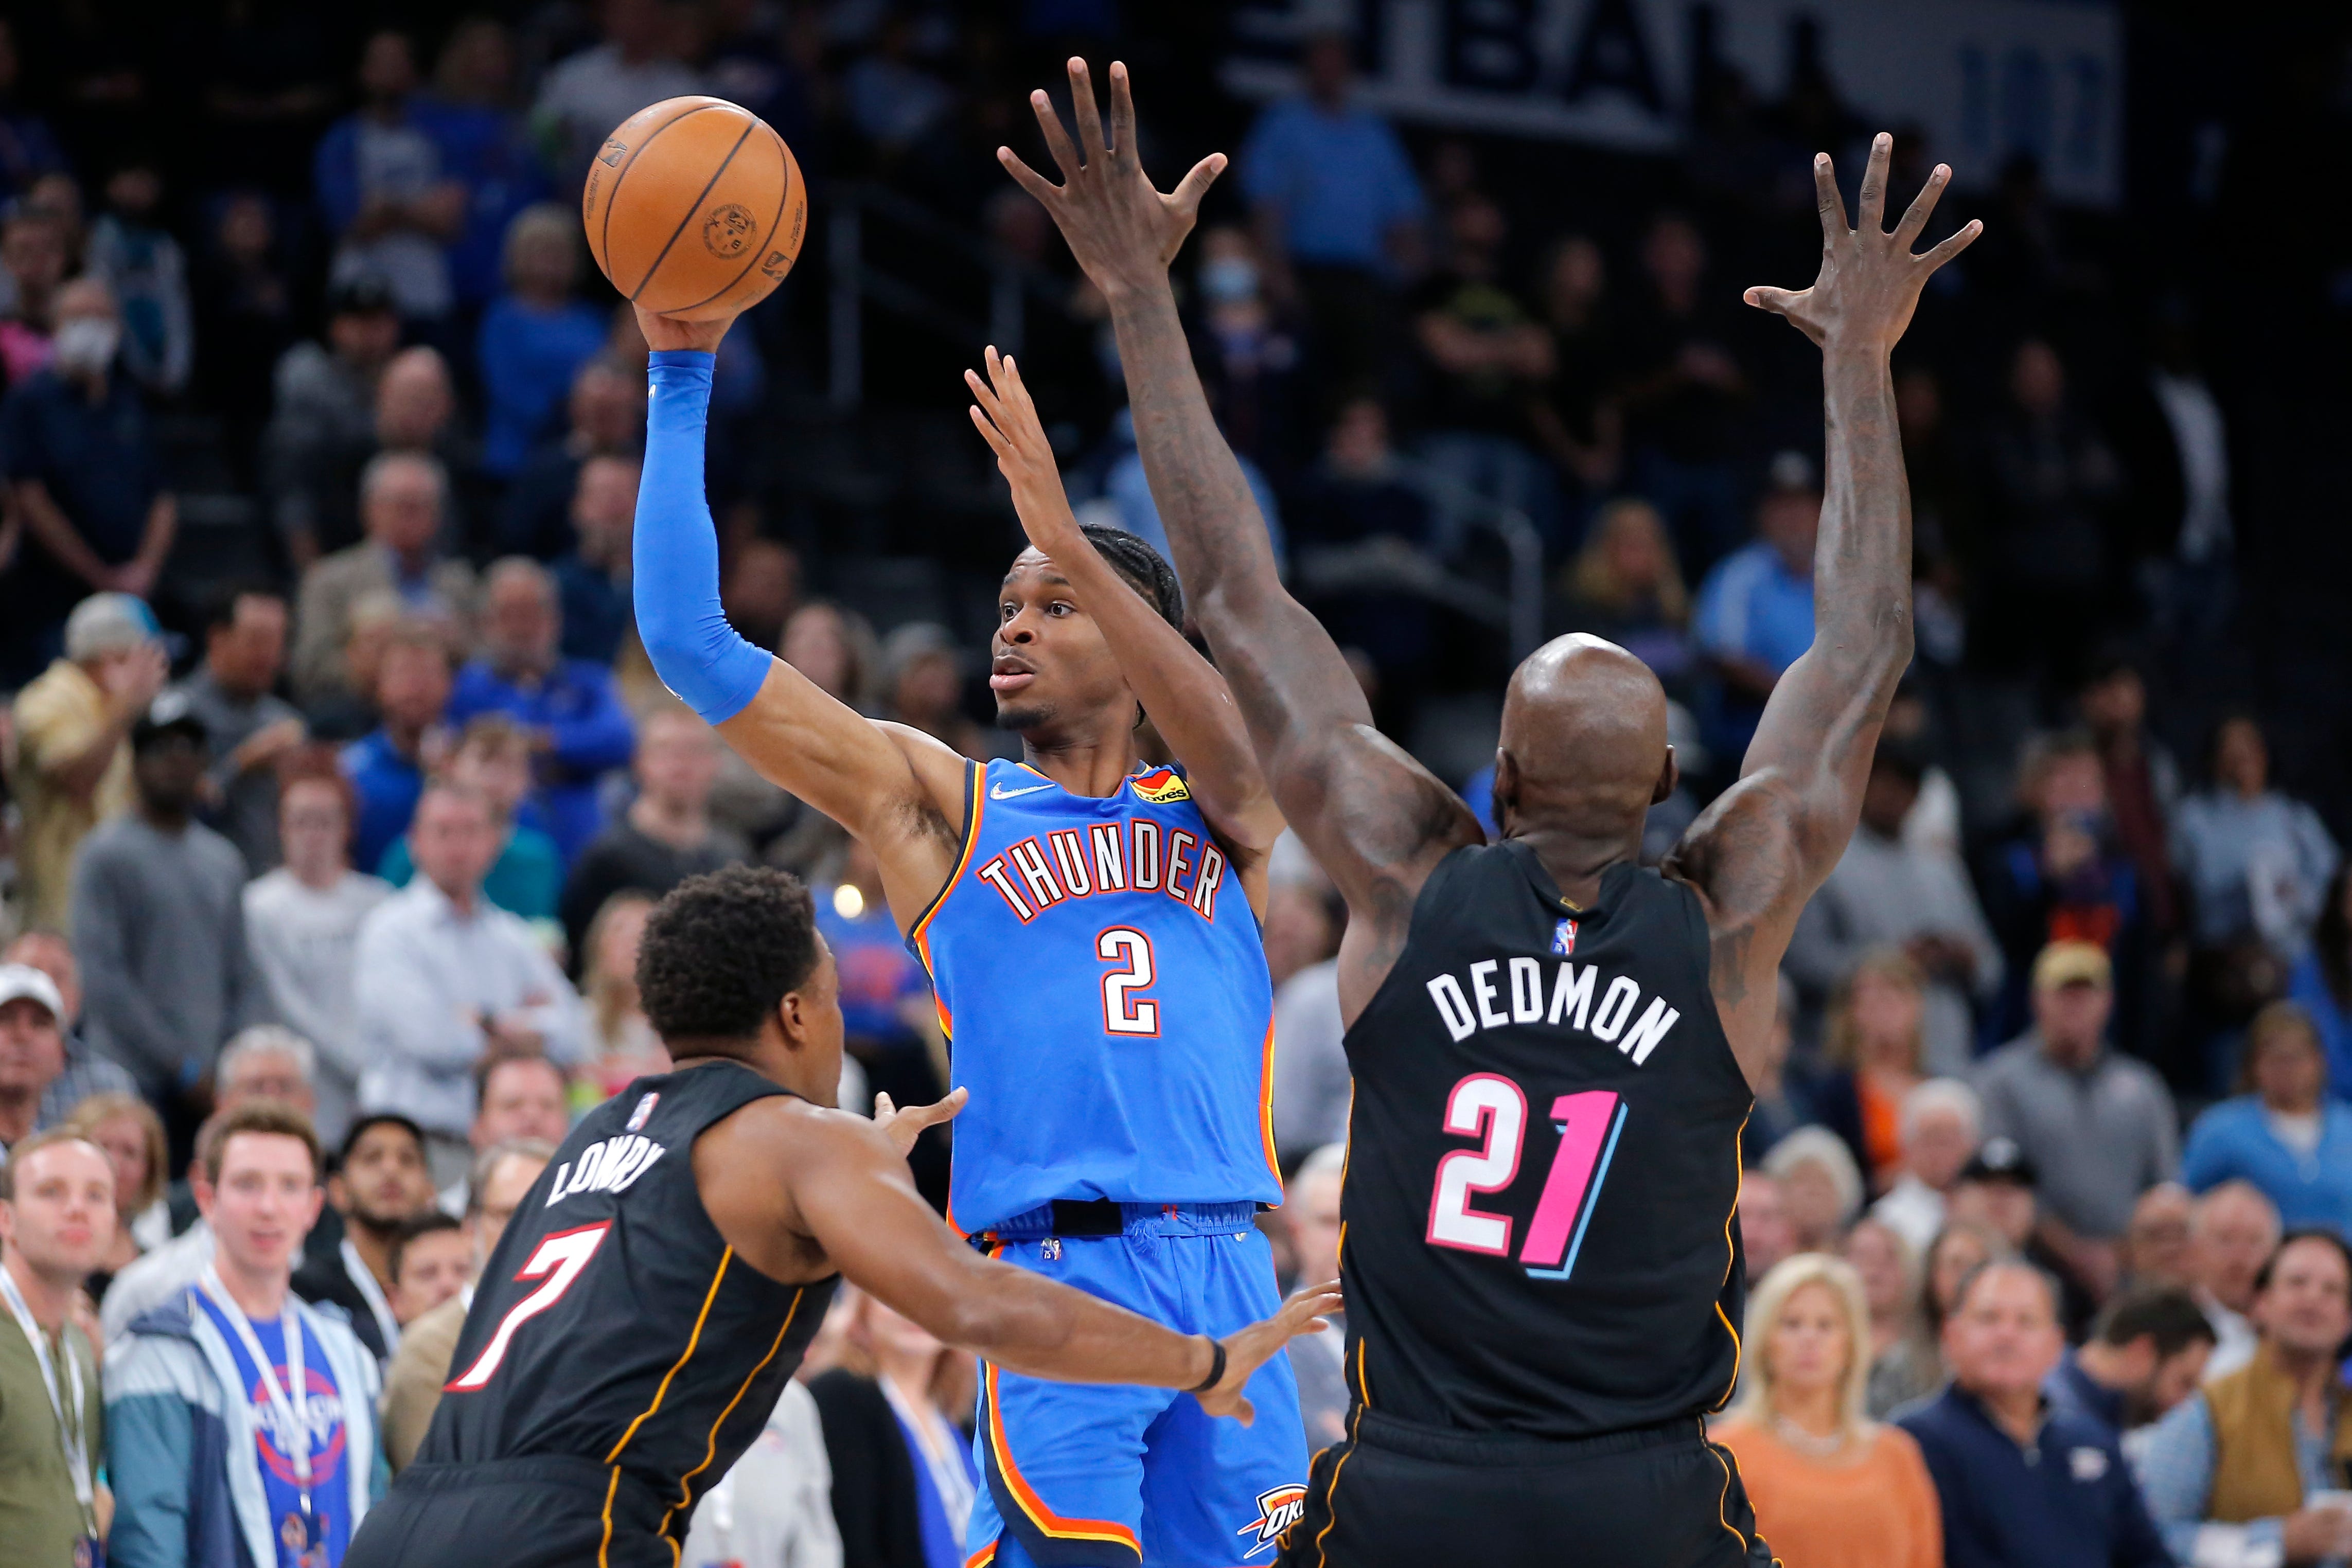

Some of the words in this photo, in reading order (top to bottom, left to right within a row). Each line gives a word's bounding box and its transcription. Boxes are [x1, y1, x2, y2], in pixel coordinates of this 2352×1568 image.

[976, 818, 1226, 924] THUNDER
[1095, 925, 1160, 1038] 2
[1426, 957, 1681, 1066] DEDMON
[544, 1134, 666, 1209] LOWRY
[1425, 1072, 1629, 1280] 21
[443, 1218, 613, 1392] 7
